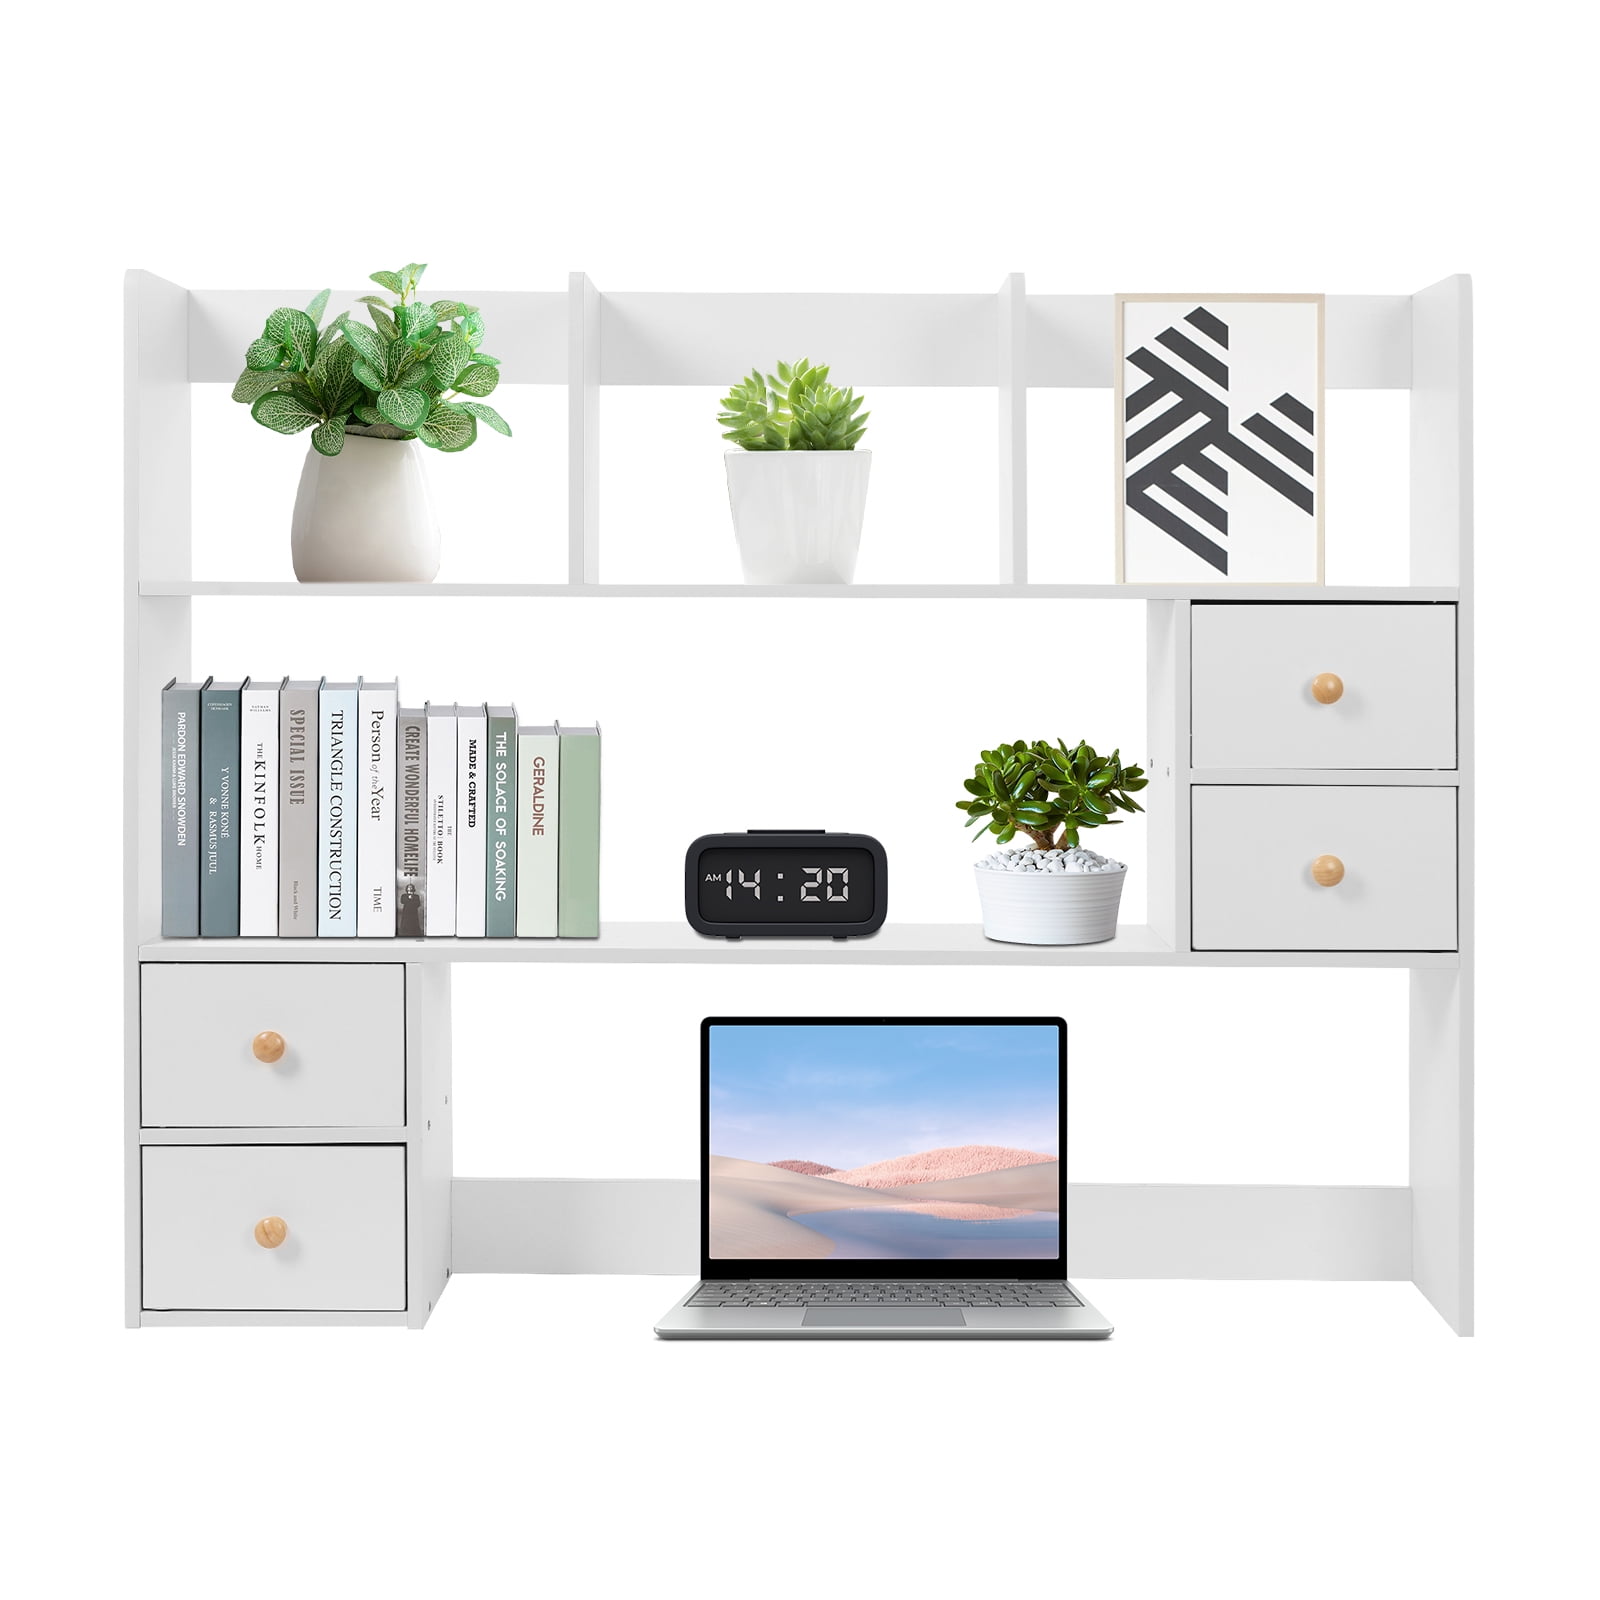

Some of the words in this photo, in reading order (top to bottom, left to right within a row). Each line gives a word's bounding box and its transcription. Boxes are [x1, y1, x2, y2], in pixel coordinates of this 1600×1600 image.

[177, 711, 186, 752] PARDON
[290, 709, 306, 764] SPECIAL
[330, 709, 344, 792] TRIANGLE
[371, 710, 384, 762] Person
[405, 725, 420, 761] CREATE
[495, 731, 507, 757] THE
[370, 763, 379, 773] of
[468, 739, 477, 770] MADE
[177, 753, 186, 796] EDWARD
[289, 769, 305, 805] ISSUE
[371, 776, 380, 789] the
[469, 771, 476, 780] &
[495, 762, 507, 813] SOLACE
[208, 797, 217, 805] &
[253, 760, 266, 847] KINFOLK
[371, 787, 384, 821] Year
[404, 764, 420, 825] WONDERFUL
[468, 781, 477, 828] CRAFTED
[532, 756, 545, 836] GERALDINE
[177, 797, 187, 846] SNOWDEN
[208, 811, 217, 850] RASMUS
[220, 811, 230, 839] KONÉ
[495, 817, 507, 836] OF
[207, 850, 217, 875] JUUL
[328, 794, 343, 920] CONSTRUCTION
[403, 827, 420, 877] HOMELIFE
[495, 841, 507, 902] SOAKING
[705, 874, 721, 882] AM
[373, 886, 382, 912] TIME
